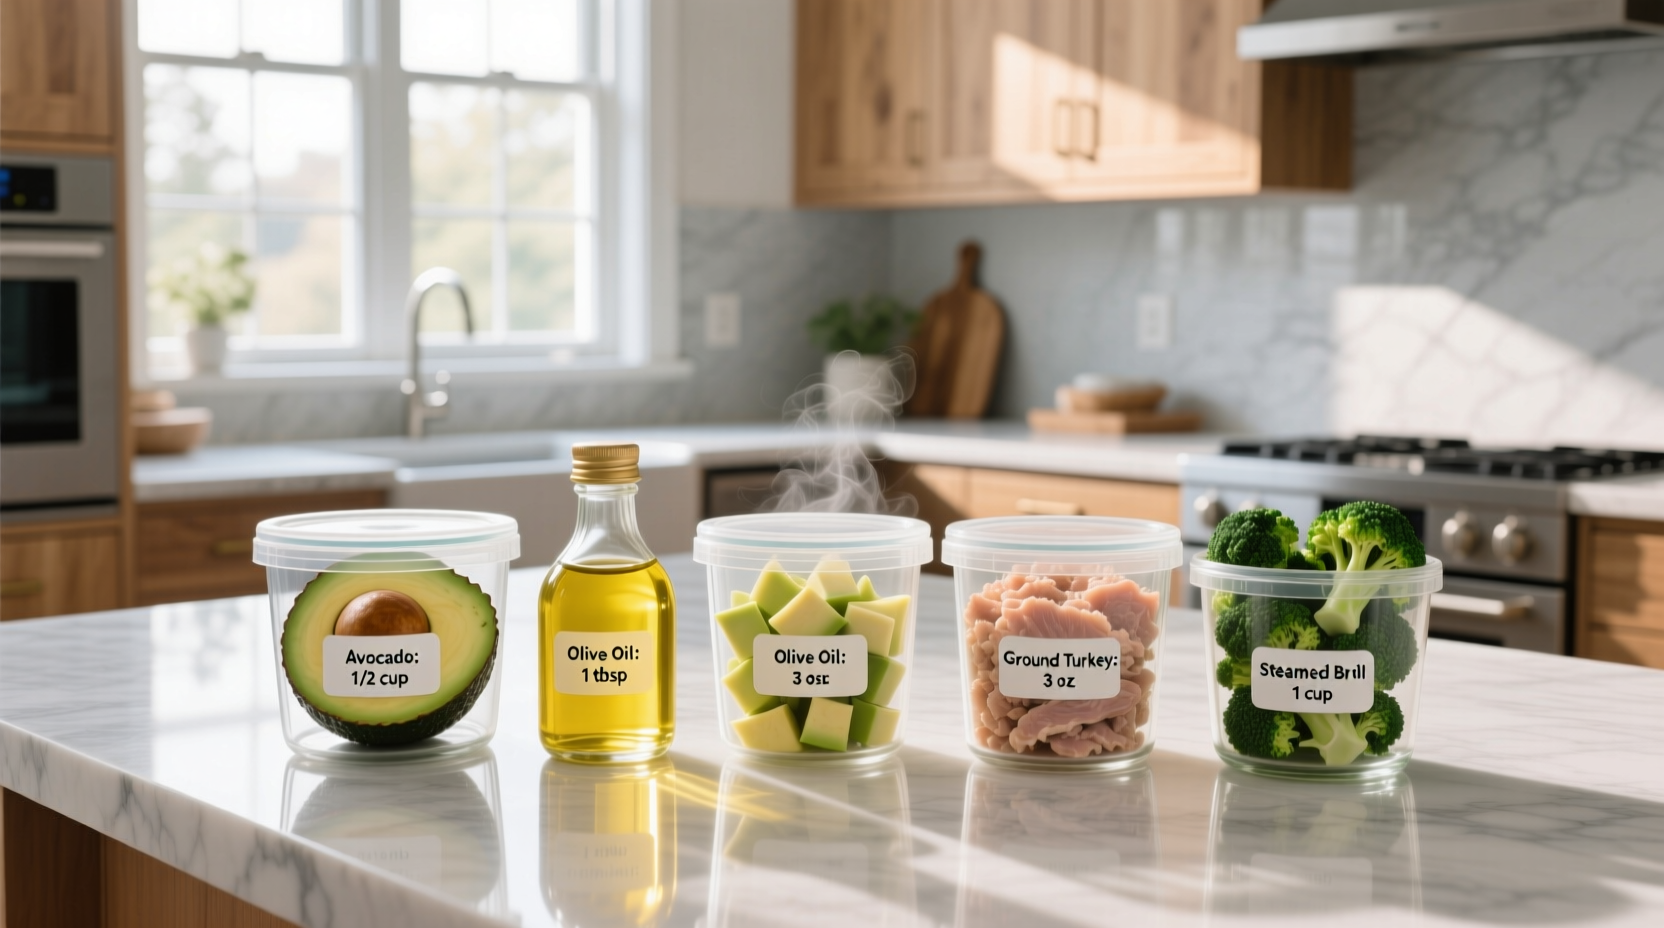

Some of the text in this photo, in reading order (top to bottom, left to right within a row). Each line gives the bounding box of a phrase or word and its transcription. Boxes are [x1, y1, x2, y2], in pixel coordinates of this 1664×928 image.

[345, 648, 419, 665] Avocado:
[567, 644, 640, 662] Olive Oil:
[773, 648, 846, 665] Olive Oil:
[1003, 649, 1118, 671] Ground Turkey:
[351, 669, 409, 689] 1/2 cup
[581, 666, 628, 687] 1 tbsp
[792, 670, 803, 686] 3
[1042, 672, 1076, 689] 3 oz
[1259, 661, 1330, 681] Steamed
[1291, 685, 1333, 705] 1 cup
